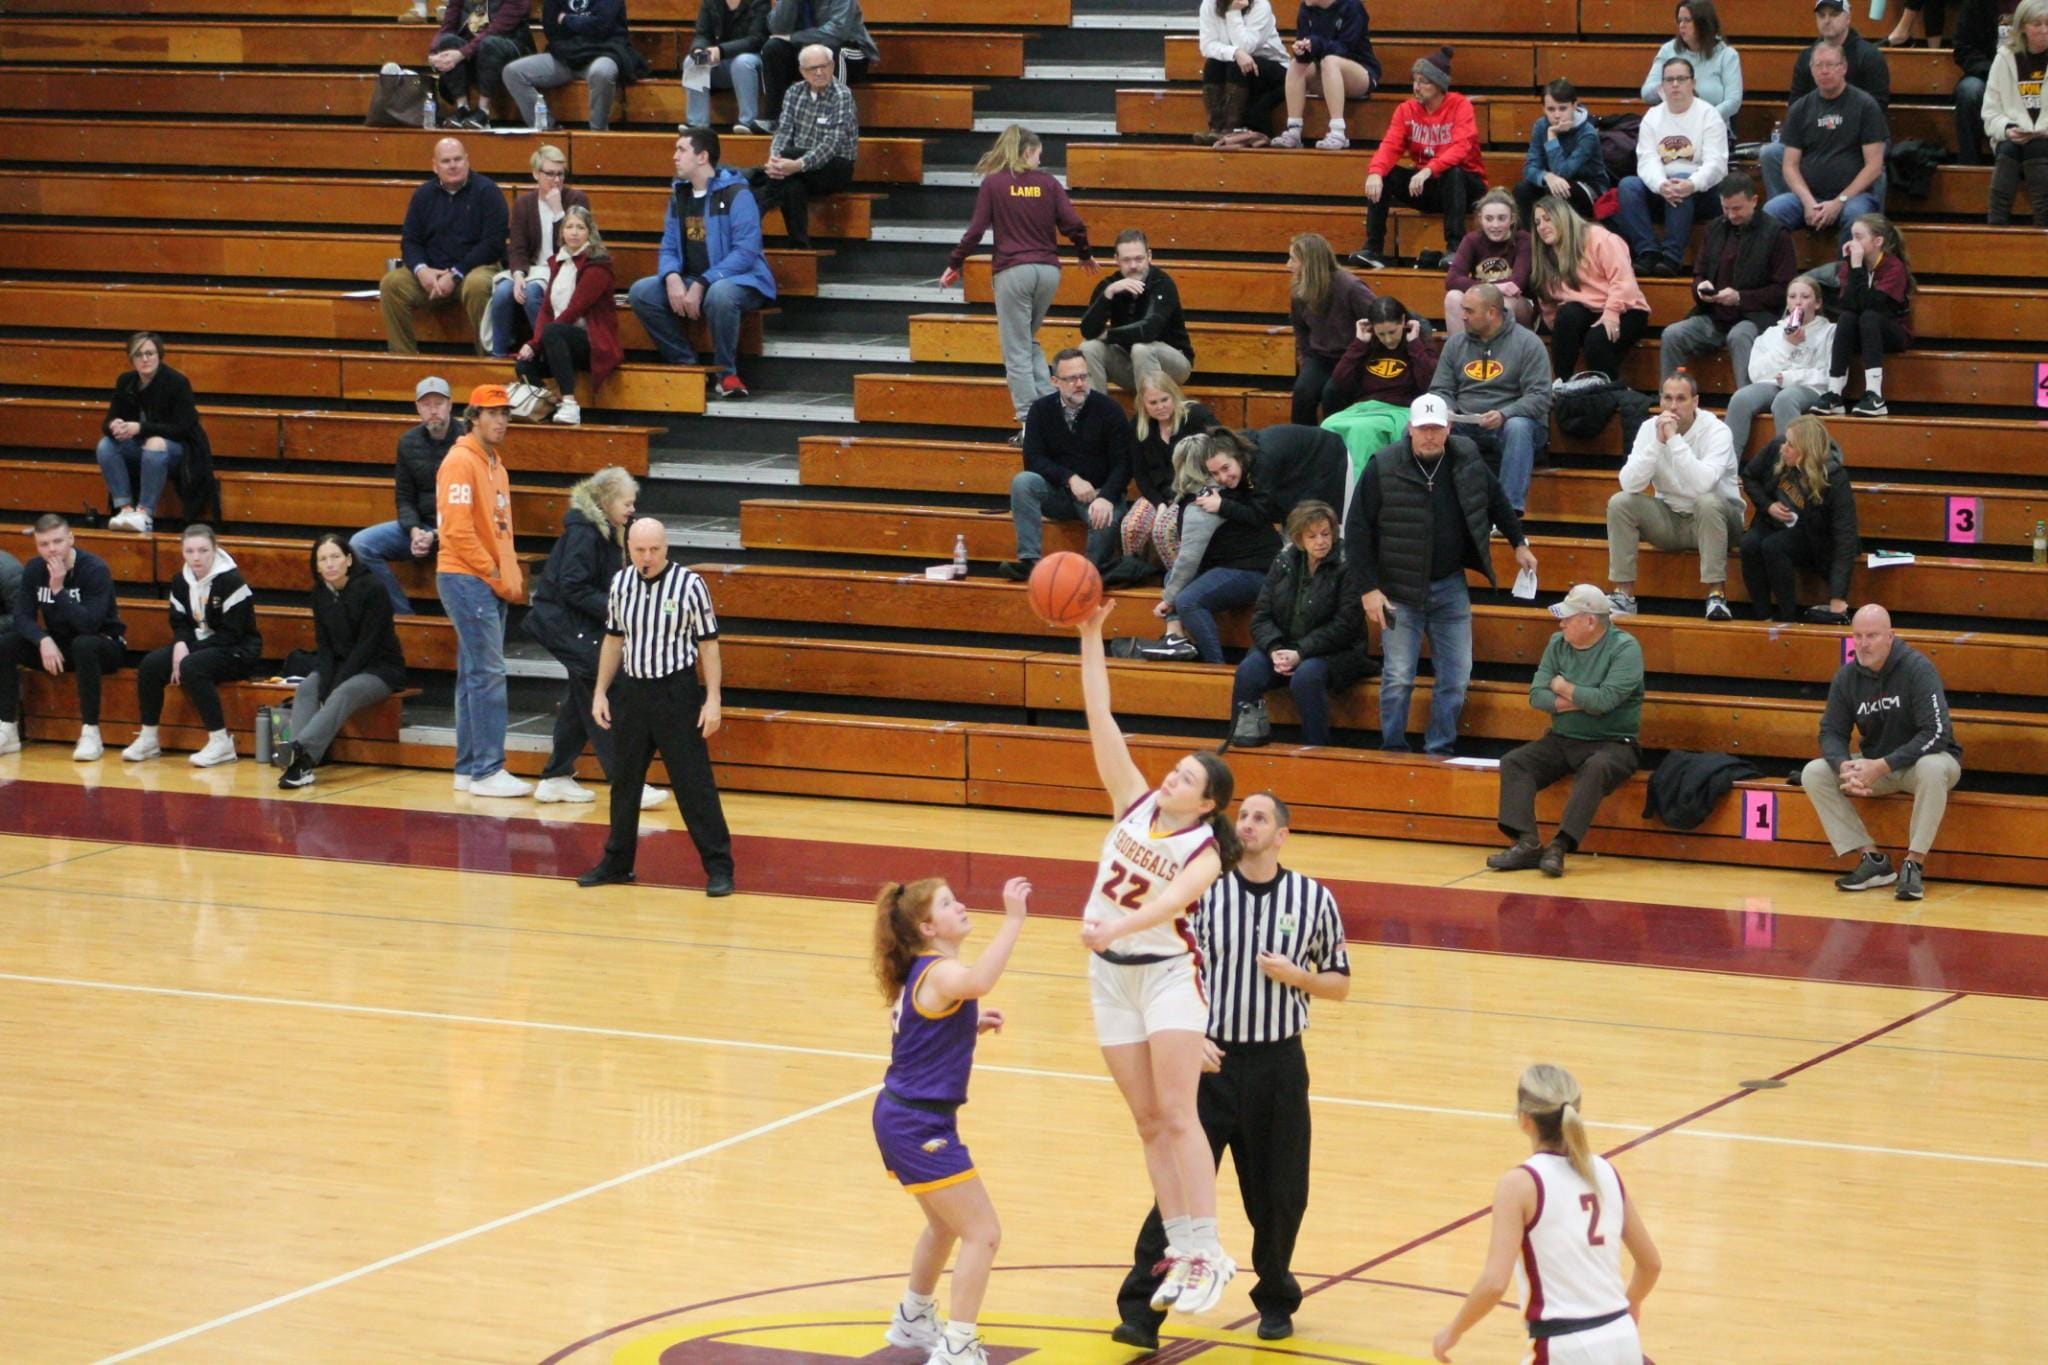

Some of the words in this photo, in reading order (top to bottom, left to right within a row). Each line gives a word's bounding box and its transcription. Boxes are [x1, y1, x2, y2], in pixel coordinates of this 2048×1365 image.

[1010, 184, 1041, 198] LAMB
[447, 483, 473, 505] 28
[1956, 508, 1975, 532] 3
[1756, 803, 1770, 829] 1
[1101, 859, 1151, 911] 22
[1579, 1193, 1605, 1246] 2
